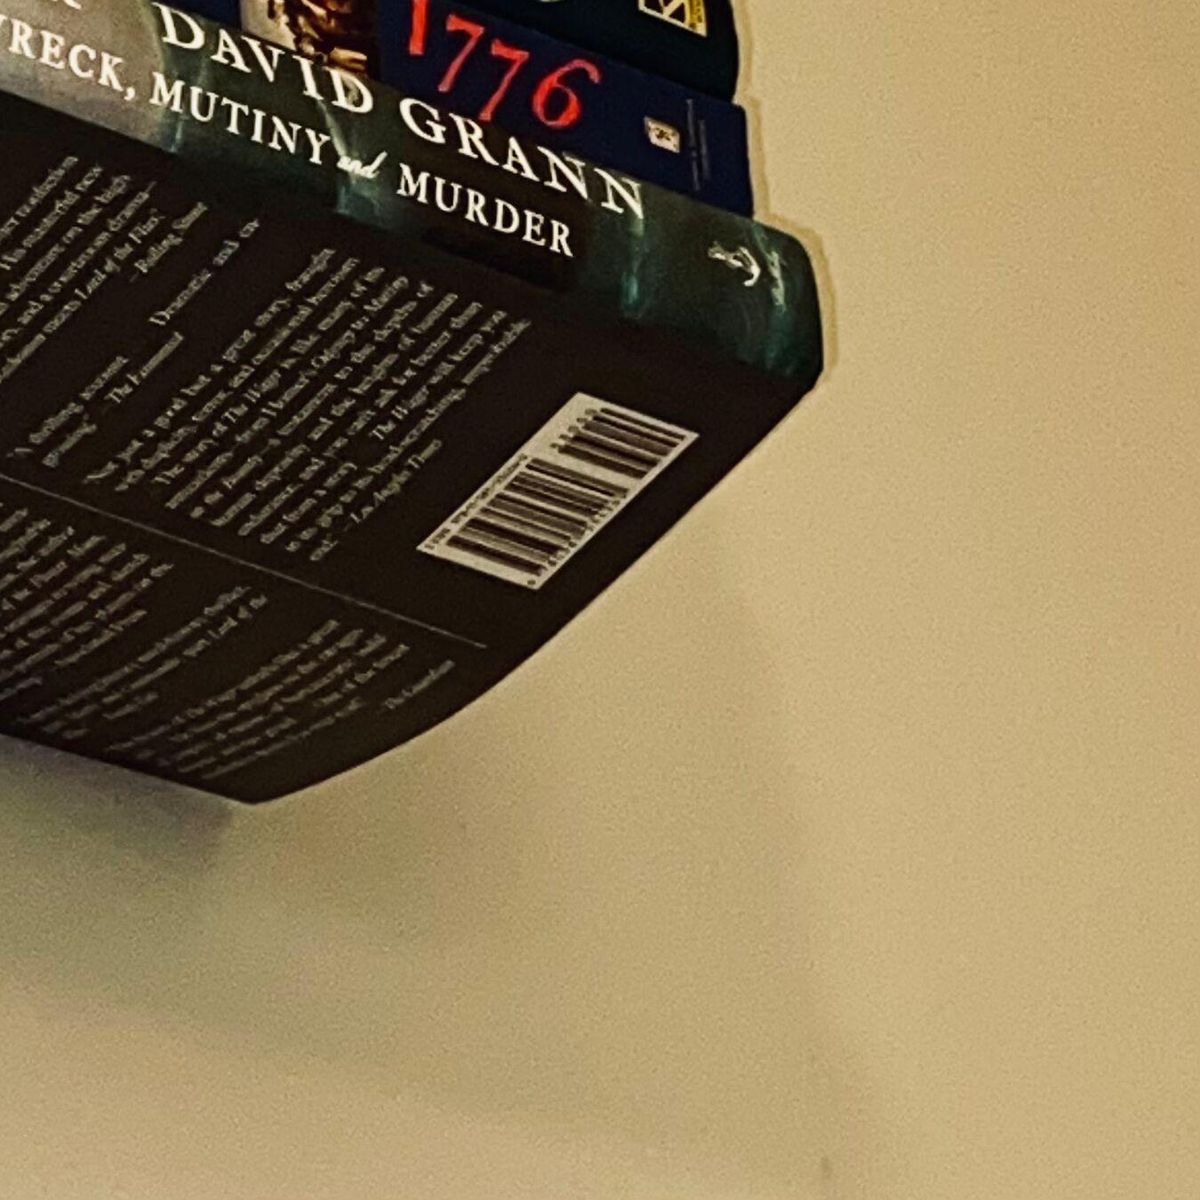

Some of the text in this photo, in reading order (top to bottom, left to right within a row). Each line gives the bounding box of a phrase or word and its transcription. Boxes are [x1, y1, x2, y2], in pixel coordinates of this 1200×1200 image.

[149, 70, 332, 167] MUTINY
[336, 150, 388, 180] and
[397, 161, 574, 258] MURDER
[152, 2, 375, 114] DAVID
[400, 97, 645, 220] GRANN
